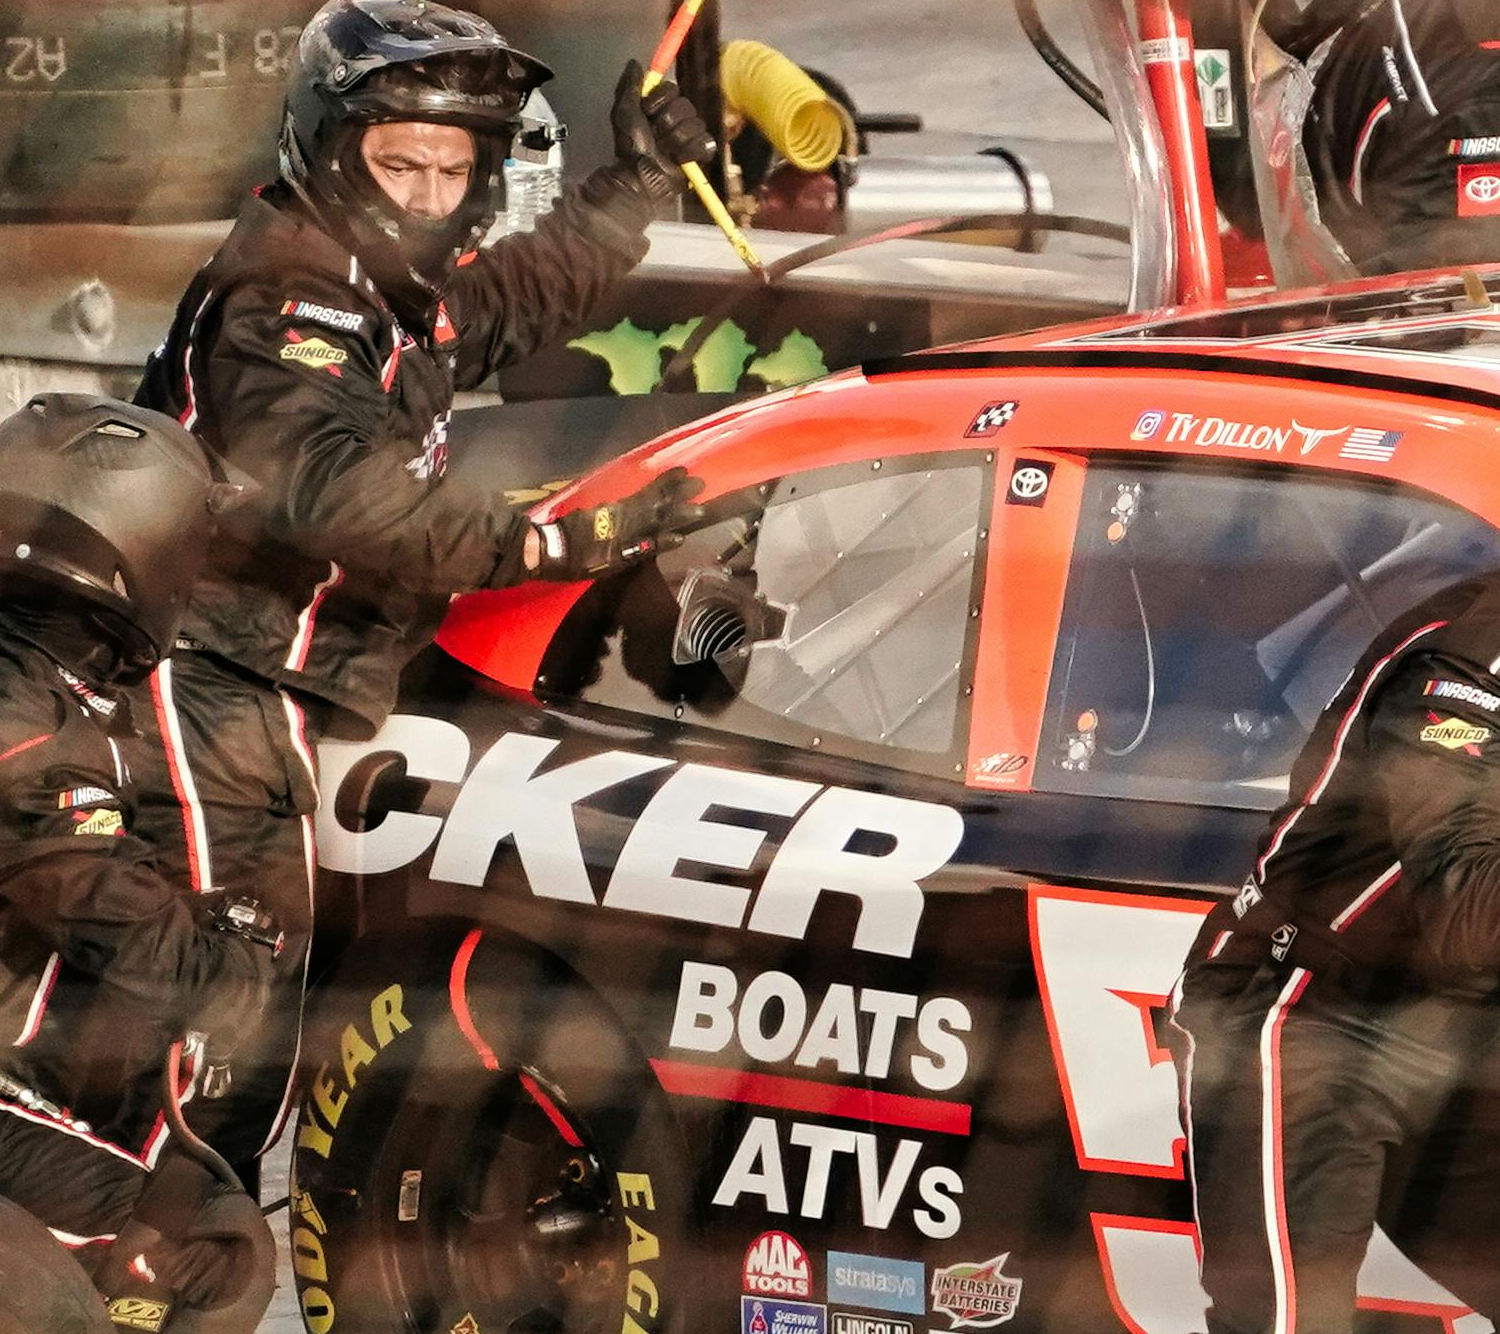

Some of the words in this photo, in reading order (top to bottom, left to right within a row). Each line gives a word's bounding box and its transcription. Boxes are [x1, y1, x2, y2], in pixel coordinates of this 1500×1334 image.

[300, 301, 364, 331] NASCAR
[283, 344, 345, 361] SUNOCO
[1440, 681, 1500, 712] NASCAR
[1424, 725, 1489, 741] SUNOCO
[315, 712, 966, 959] CKER
[670, 960, 974, 1092] BOATS
[713, 1118, 966, 1240] ATVs
[746, 1234, 809, 1274] MAC
[746, 1273, 809, 1297] TOOLS
[834, 1266, 916, 1298] stratasys
[937, 1276, 1016, 1299] INTERSTATE
[774, 1309, 819, 1327] SHERWIN
[939, 1294, 1012, 1314] BATTERIES
